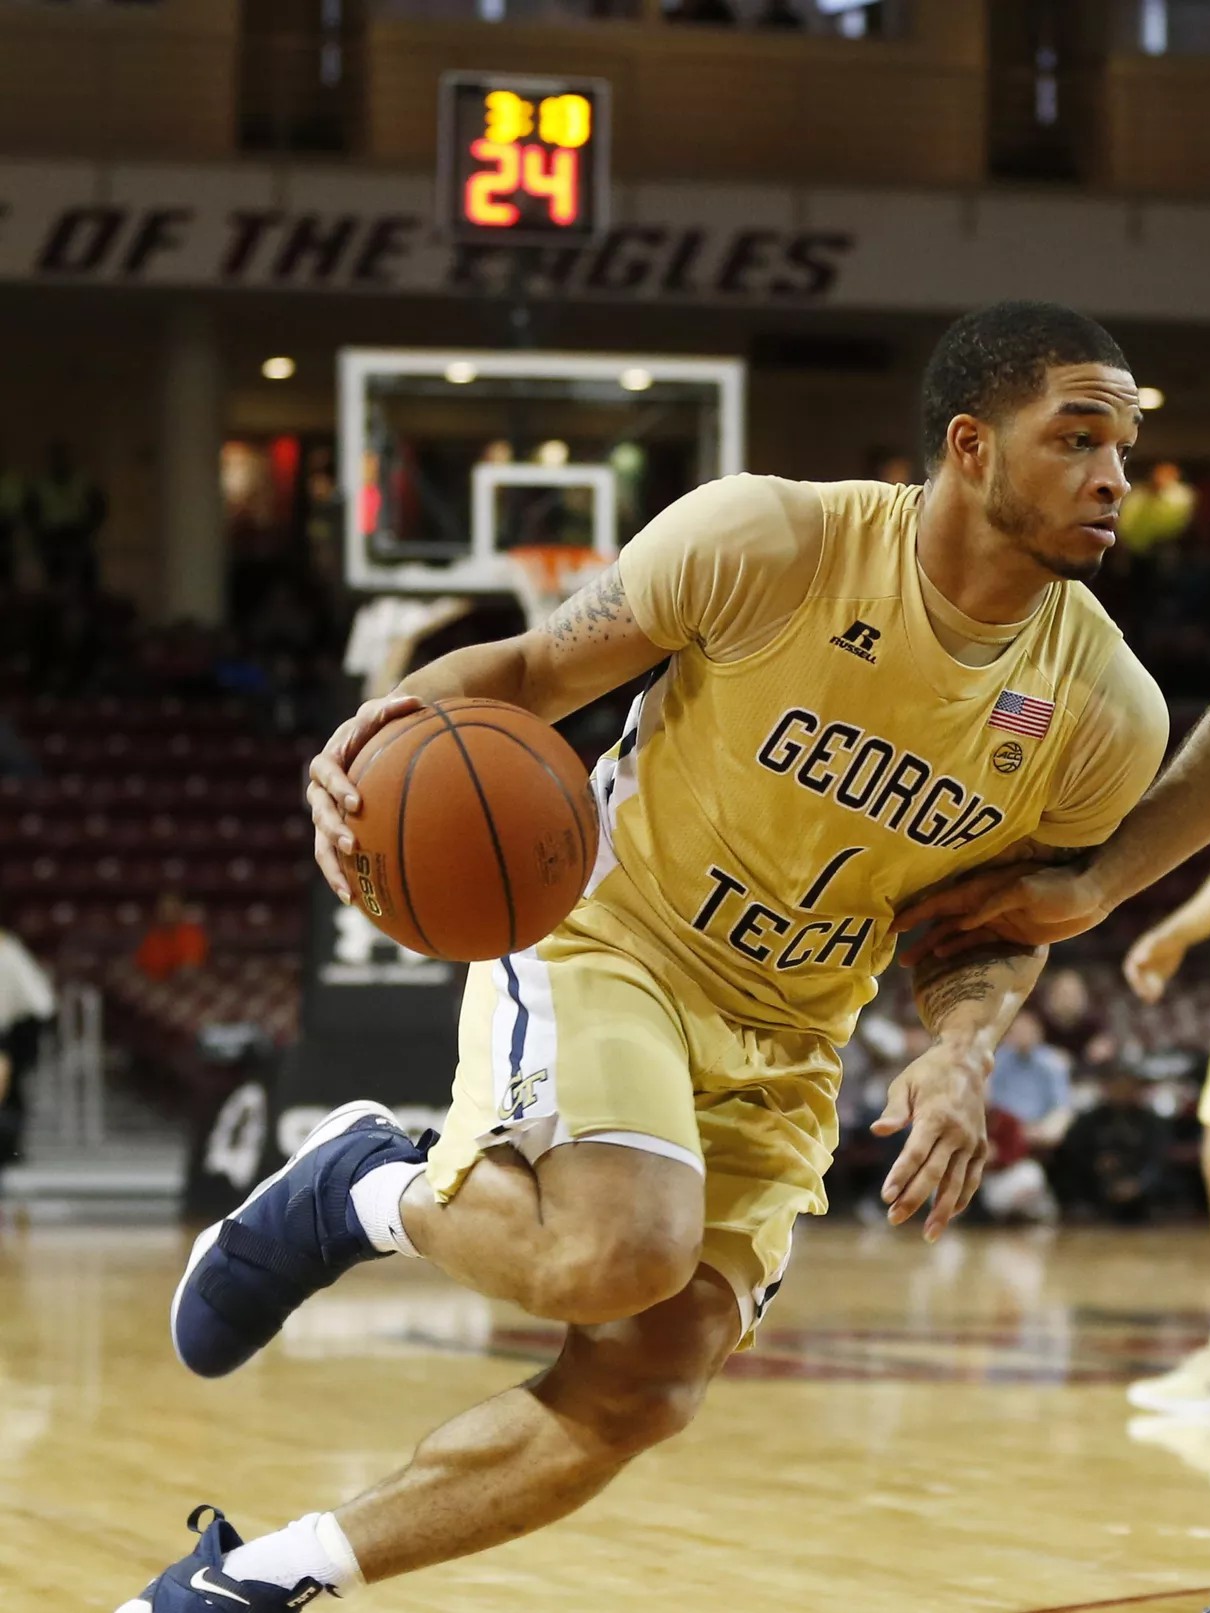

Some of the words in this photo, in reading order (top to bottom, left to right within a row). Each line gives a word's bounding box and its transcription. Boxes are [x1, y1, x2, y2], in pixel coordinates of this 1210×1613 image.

[464, 139, 578, 227] 24
[35, 207, 195, 277] OF
[216, 207, 422, 283] THE
[829, 635, 878, 665] RUSSELL
[755, 706, 1005, 851] GEORGIA
[692, 863, 877, 970] TECH
[797, 846, 868, 912] 1
